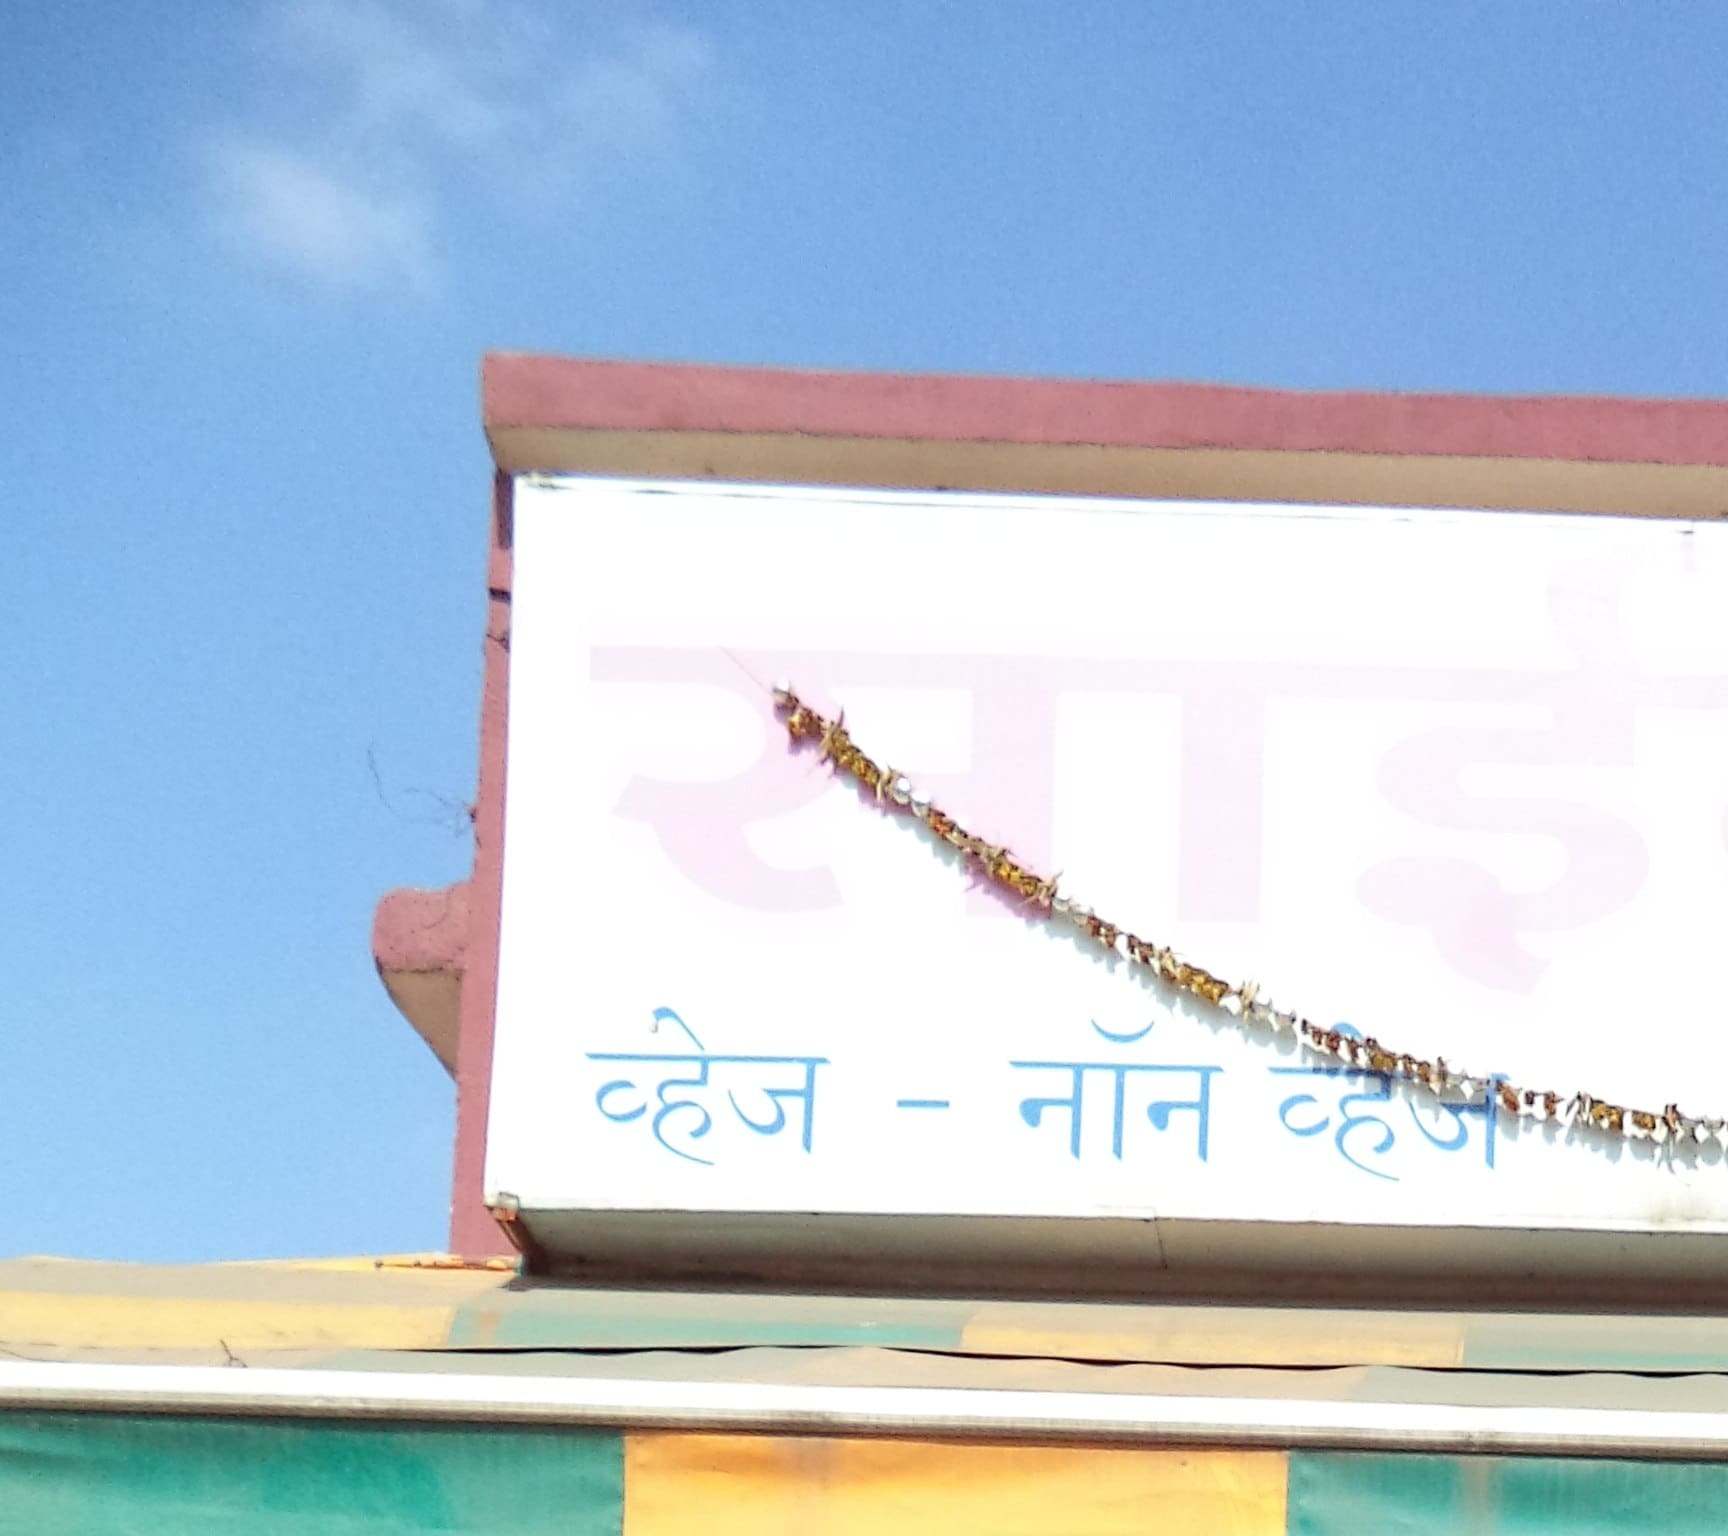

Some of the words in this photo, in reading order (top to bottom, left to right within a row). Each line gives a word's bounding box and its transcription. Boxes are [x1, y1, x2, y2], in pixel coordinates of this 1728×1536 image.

[585, 1007, 830, 1166] व्हेज
[1009, 1018, 1224, 1162] नॉन
[1267, 1022, 1510, 1181] व्हेज
